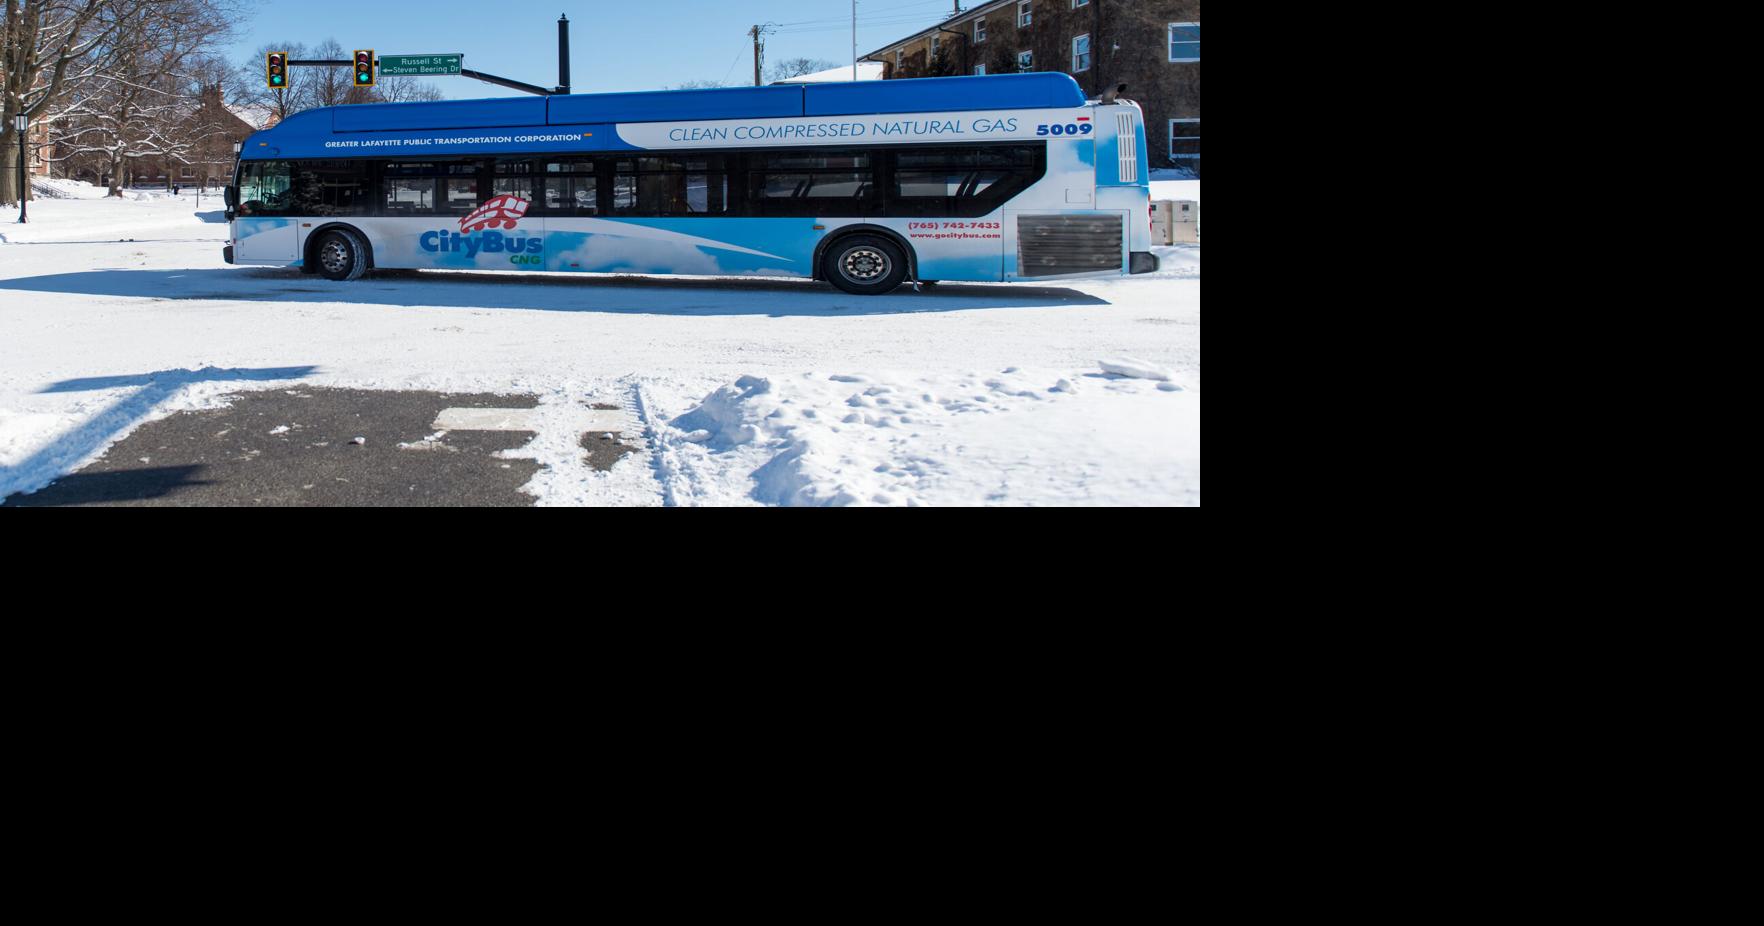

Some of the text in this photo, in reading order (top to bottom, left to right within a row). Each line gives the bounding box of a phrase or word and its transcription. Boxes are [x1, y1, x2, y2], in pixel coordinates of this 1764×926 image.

[401, 57, 442, 66] Russell St
[393, 65, 417, 74] Steven
[420, 65, 448, 74] Beering
[669, 118, 1018, 141] CLEAN COMPRESSED NATURAL GAS
[1036, 123, 1093, 136] 5009
[361, 139, 401, 148] LAFAYETTE
[403, 138, 432, 146] PUBLIC
[434, 136, 512, 145] TRANSPORTATION
[514, 134, 581, 143] CORPORATION
[908, 222, 939, 230] (765)
[419, 229, 544, 259] CityBus
[510, 255, 541, 265] CNG
